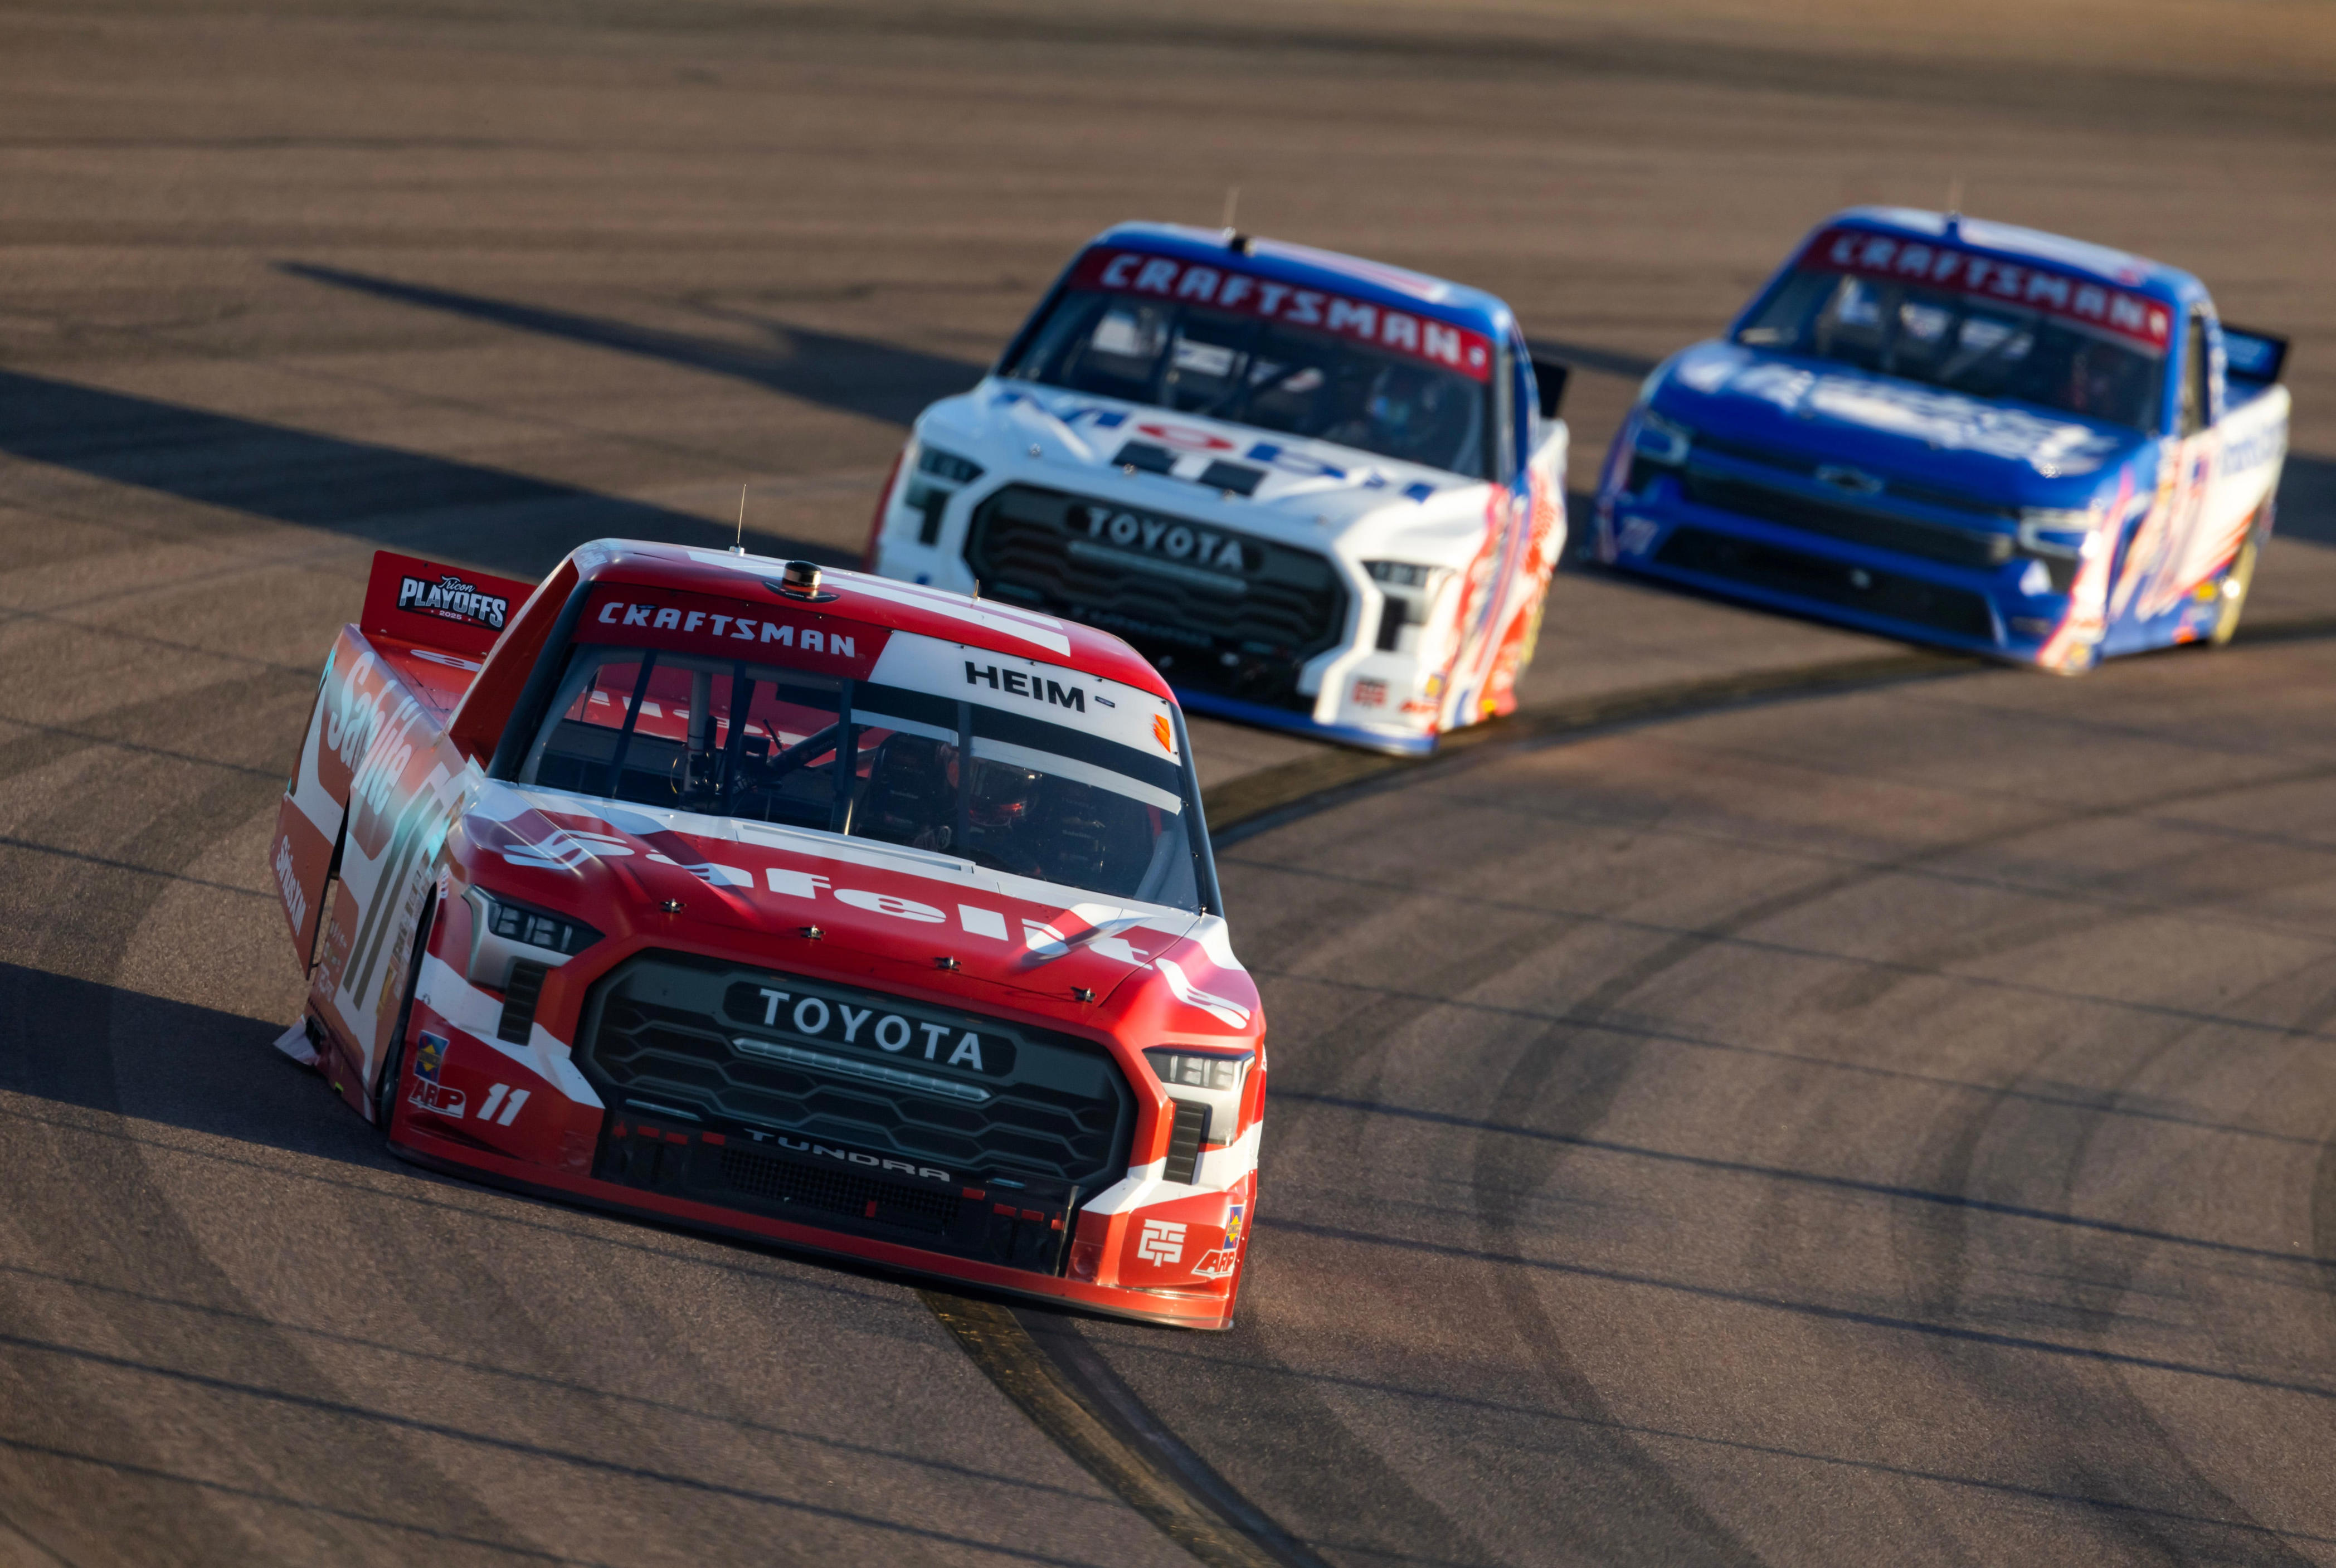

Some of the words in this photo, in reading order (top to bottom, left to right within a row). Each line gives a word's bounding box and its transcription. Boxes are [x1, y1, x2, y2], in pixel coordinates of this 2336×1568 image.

[1101, 254, 1461, 364] CRAFTSMAN
[1089, 507, 1244, 572] TOYOTA
[398, 577, 507, 628] PLAYOFFS
[441, 574, 476, 593] Tricon
[439, 609, 463, 620] 2025
[598, 601, 855, 658] CRAFTSMAN
[964, 660, 1086, 713] HEIM
[759, 988, 984, 1072] TOYOTA
[476, 1082, 532, 1127] 11
[743, 1128, 950, 1182] TUNDRA
[1196, 1250, 1236, 1274] ARP
